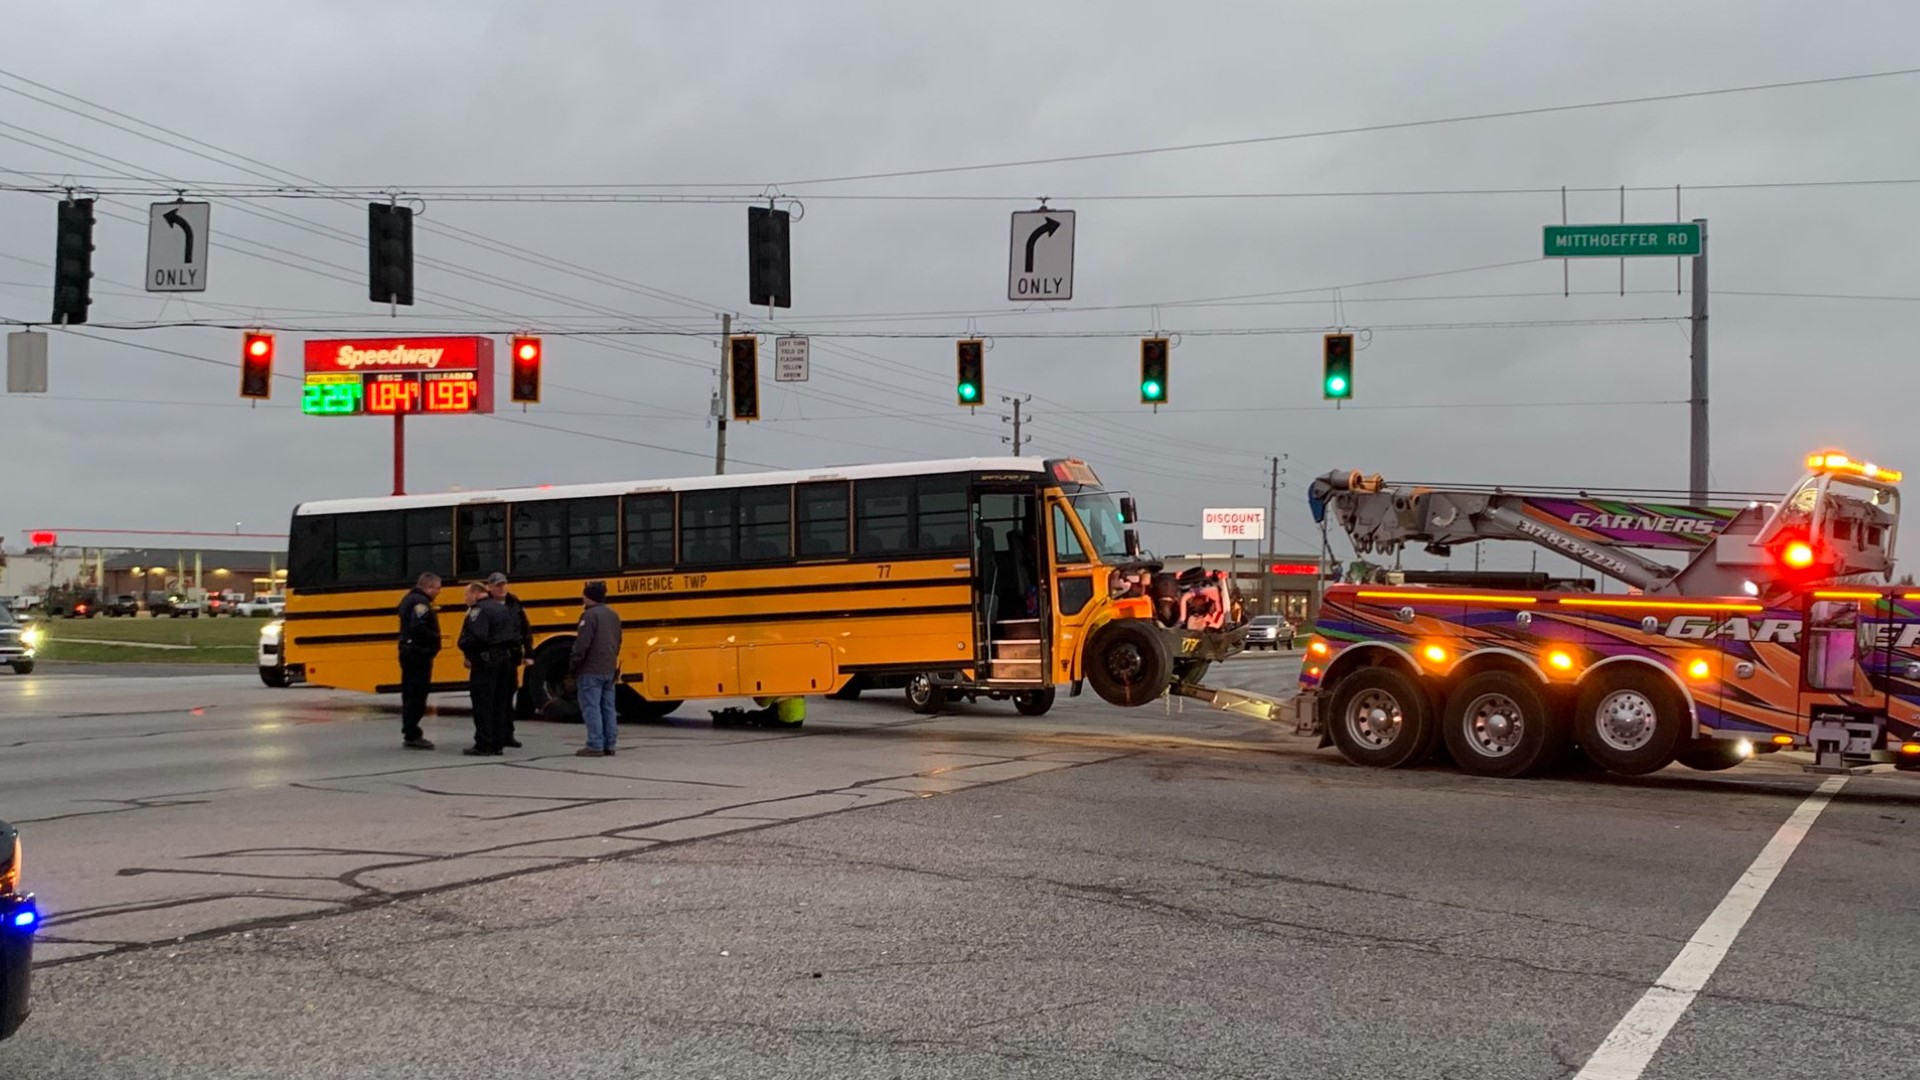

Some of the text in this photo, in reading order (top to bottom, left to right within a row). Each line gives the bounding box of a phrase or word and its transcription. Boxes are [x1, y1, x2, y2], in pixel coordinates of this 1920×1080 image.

[1556, 232, 1688, 247] MITTHOEFFER RD
[155, 268, 198, 286] ONLY
[1018, 277, 1063, 295] ONLY
[337, 345, 445, 370] Speedway
[425, 372, 474, 381] UNLEADED
[1206, 513, 1261, 523] DISCOUNT
[1568, 512, 1716, 534] GARNERS
[1222, 525, 1246, 535] TIRE
[877, 564, 892, 579] 77
[617, 576, 674, 593] LAWRENCE
[684, 575, 708, 589] TWP
